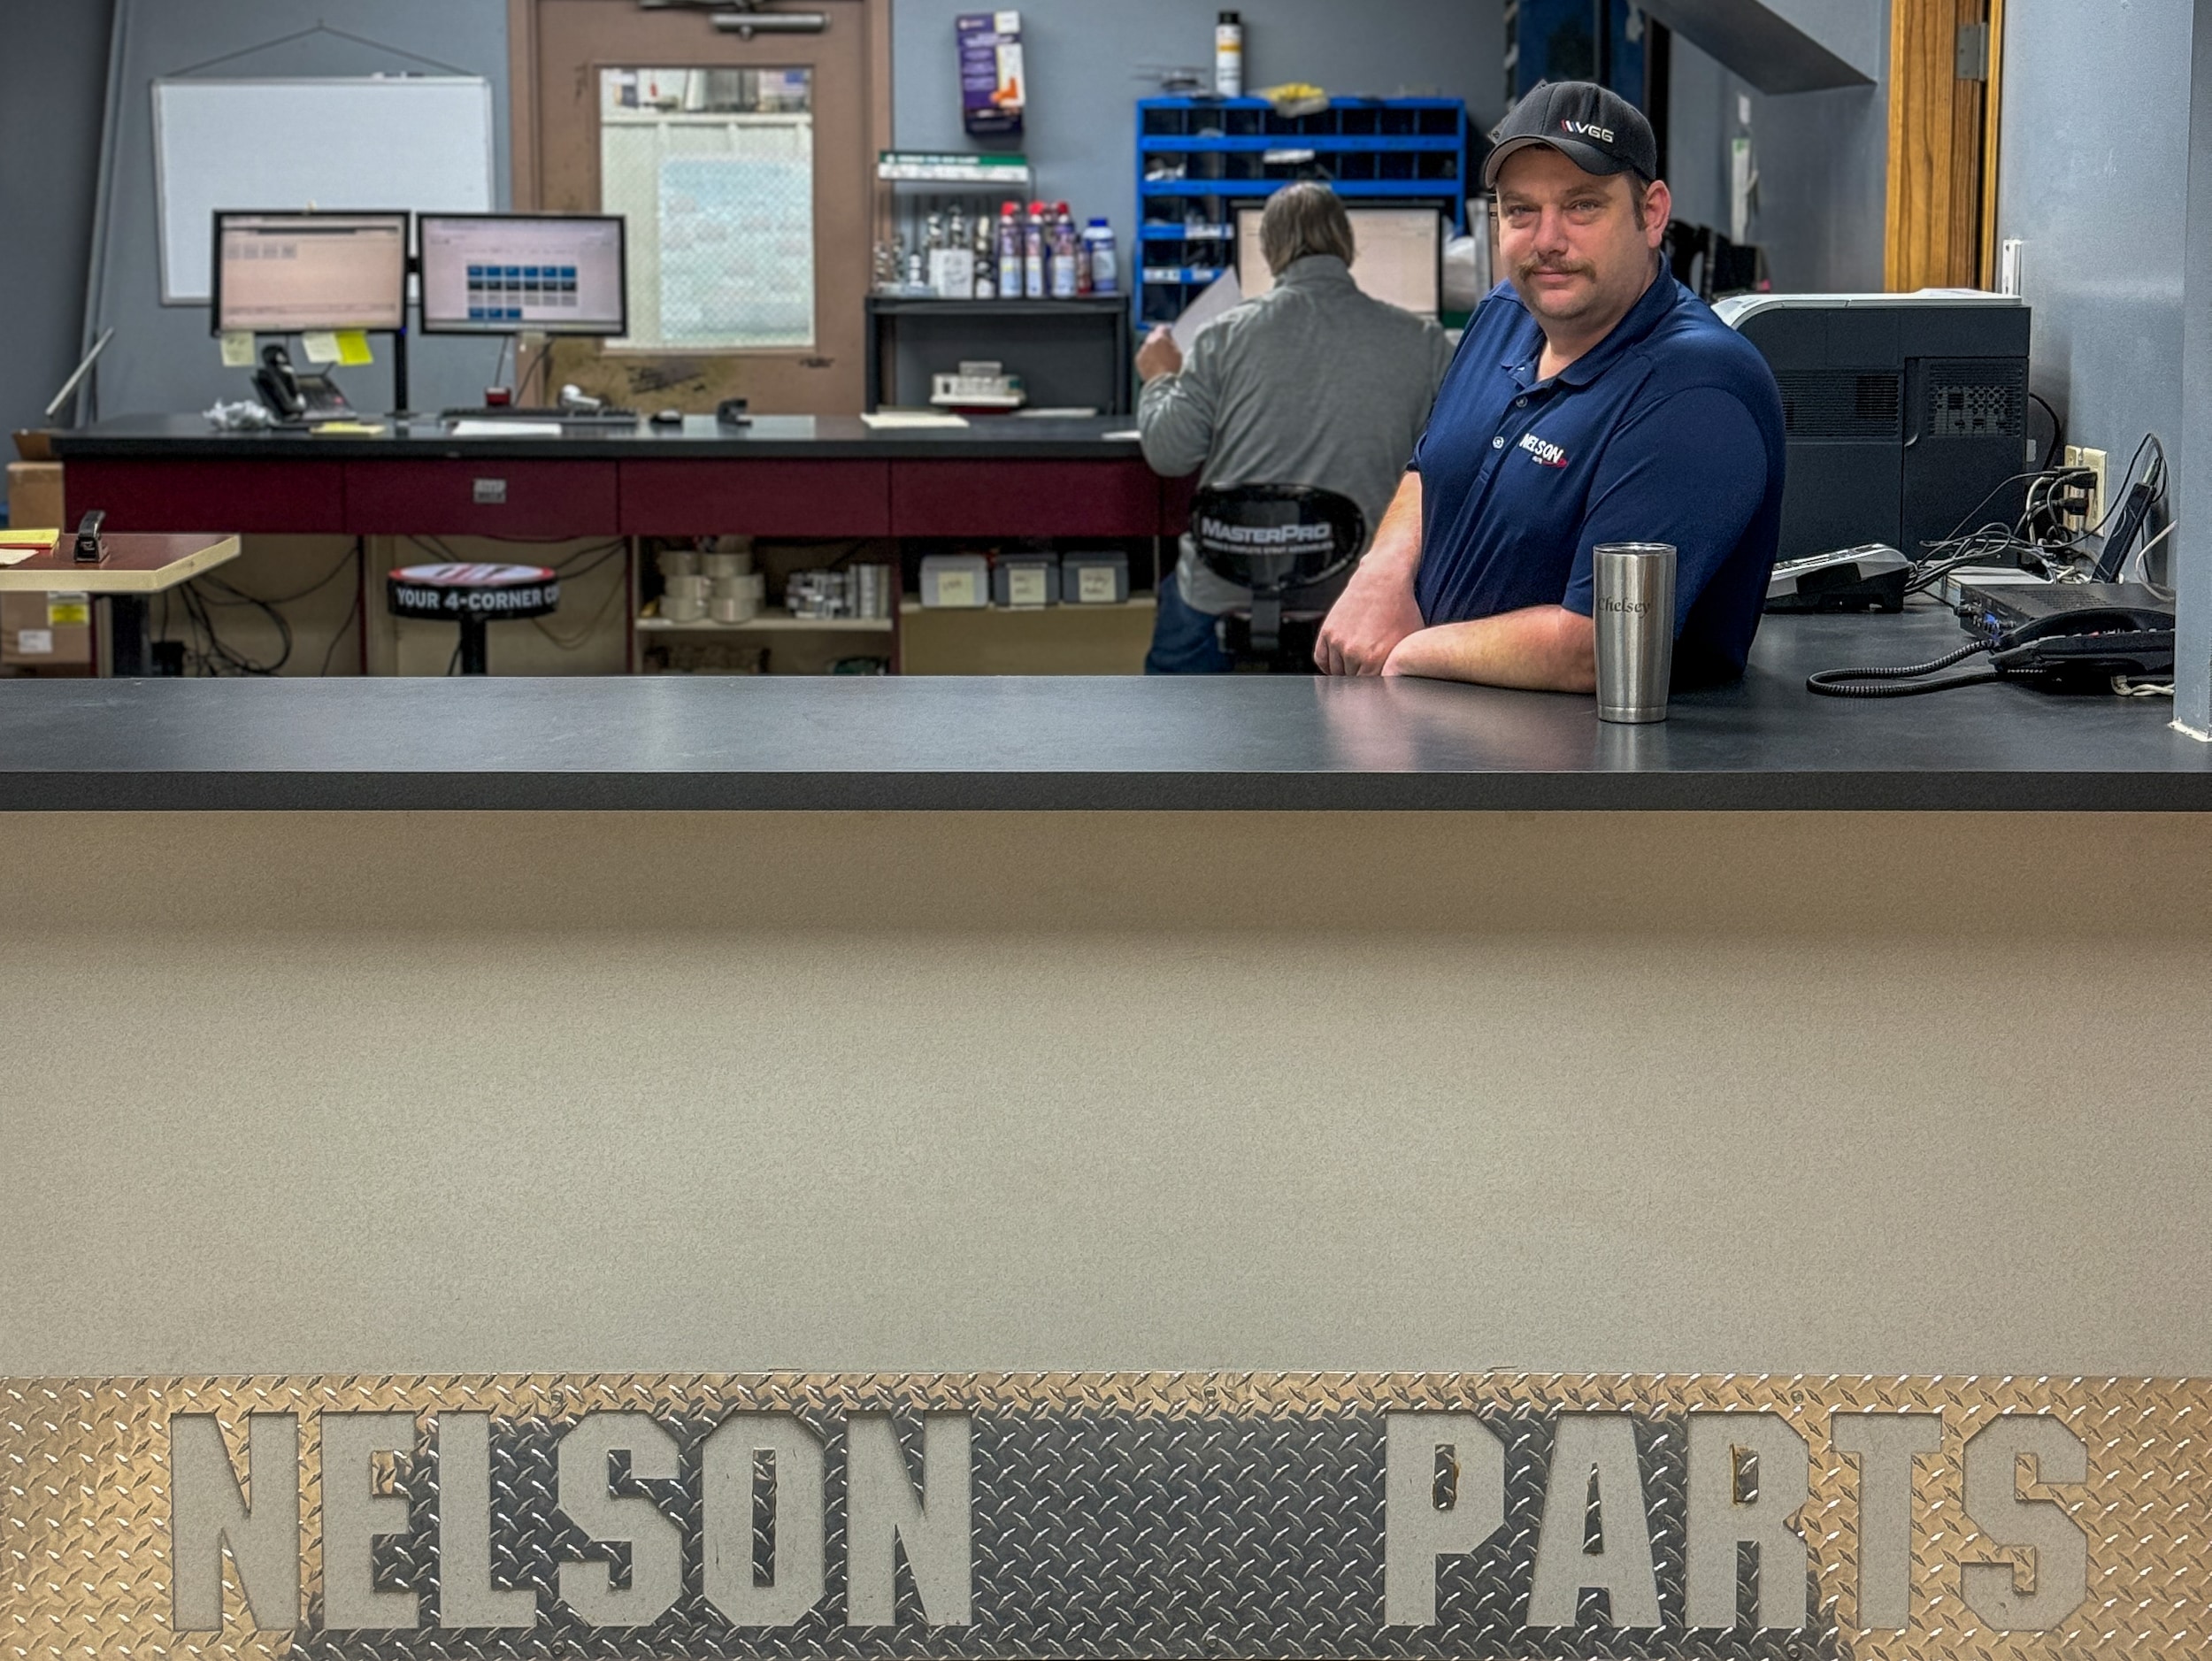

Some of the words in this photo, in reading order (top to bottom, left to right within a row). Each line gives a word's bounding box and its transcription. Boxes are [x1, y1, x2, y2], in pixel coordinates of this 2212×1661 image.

[1518, 433, 1564, 464] NELSON
[1202, 517, 1332, 543] MASTERPRO
[396, 588, 441, 610] YOUR
[445, 590, 542, 611] 4-CORNER
[1598, 596, 1650, 619] Chelsey
[170, 1411, 972, 1632] NELSON
[1384, 1411, 2089, 1633] PARTS
